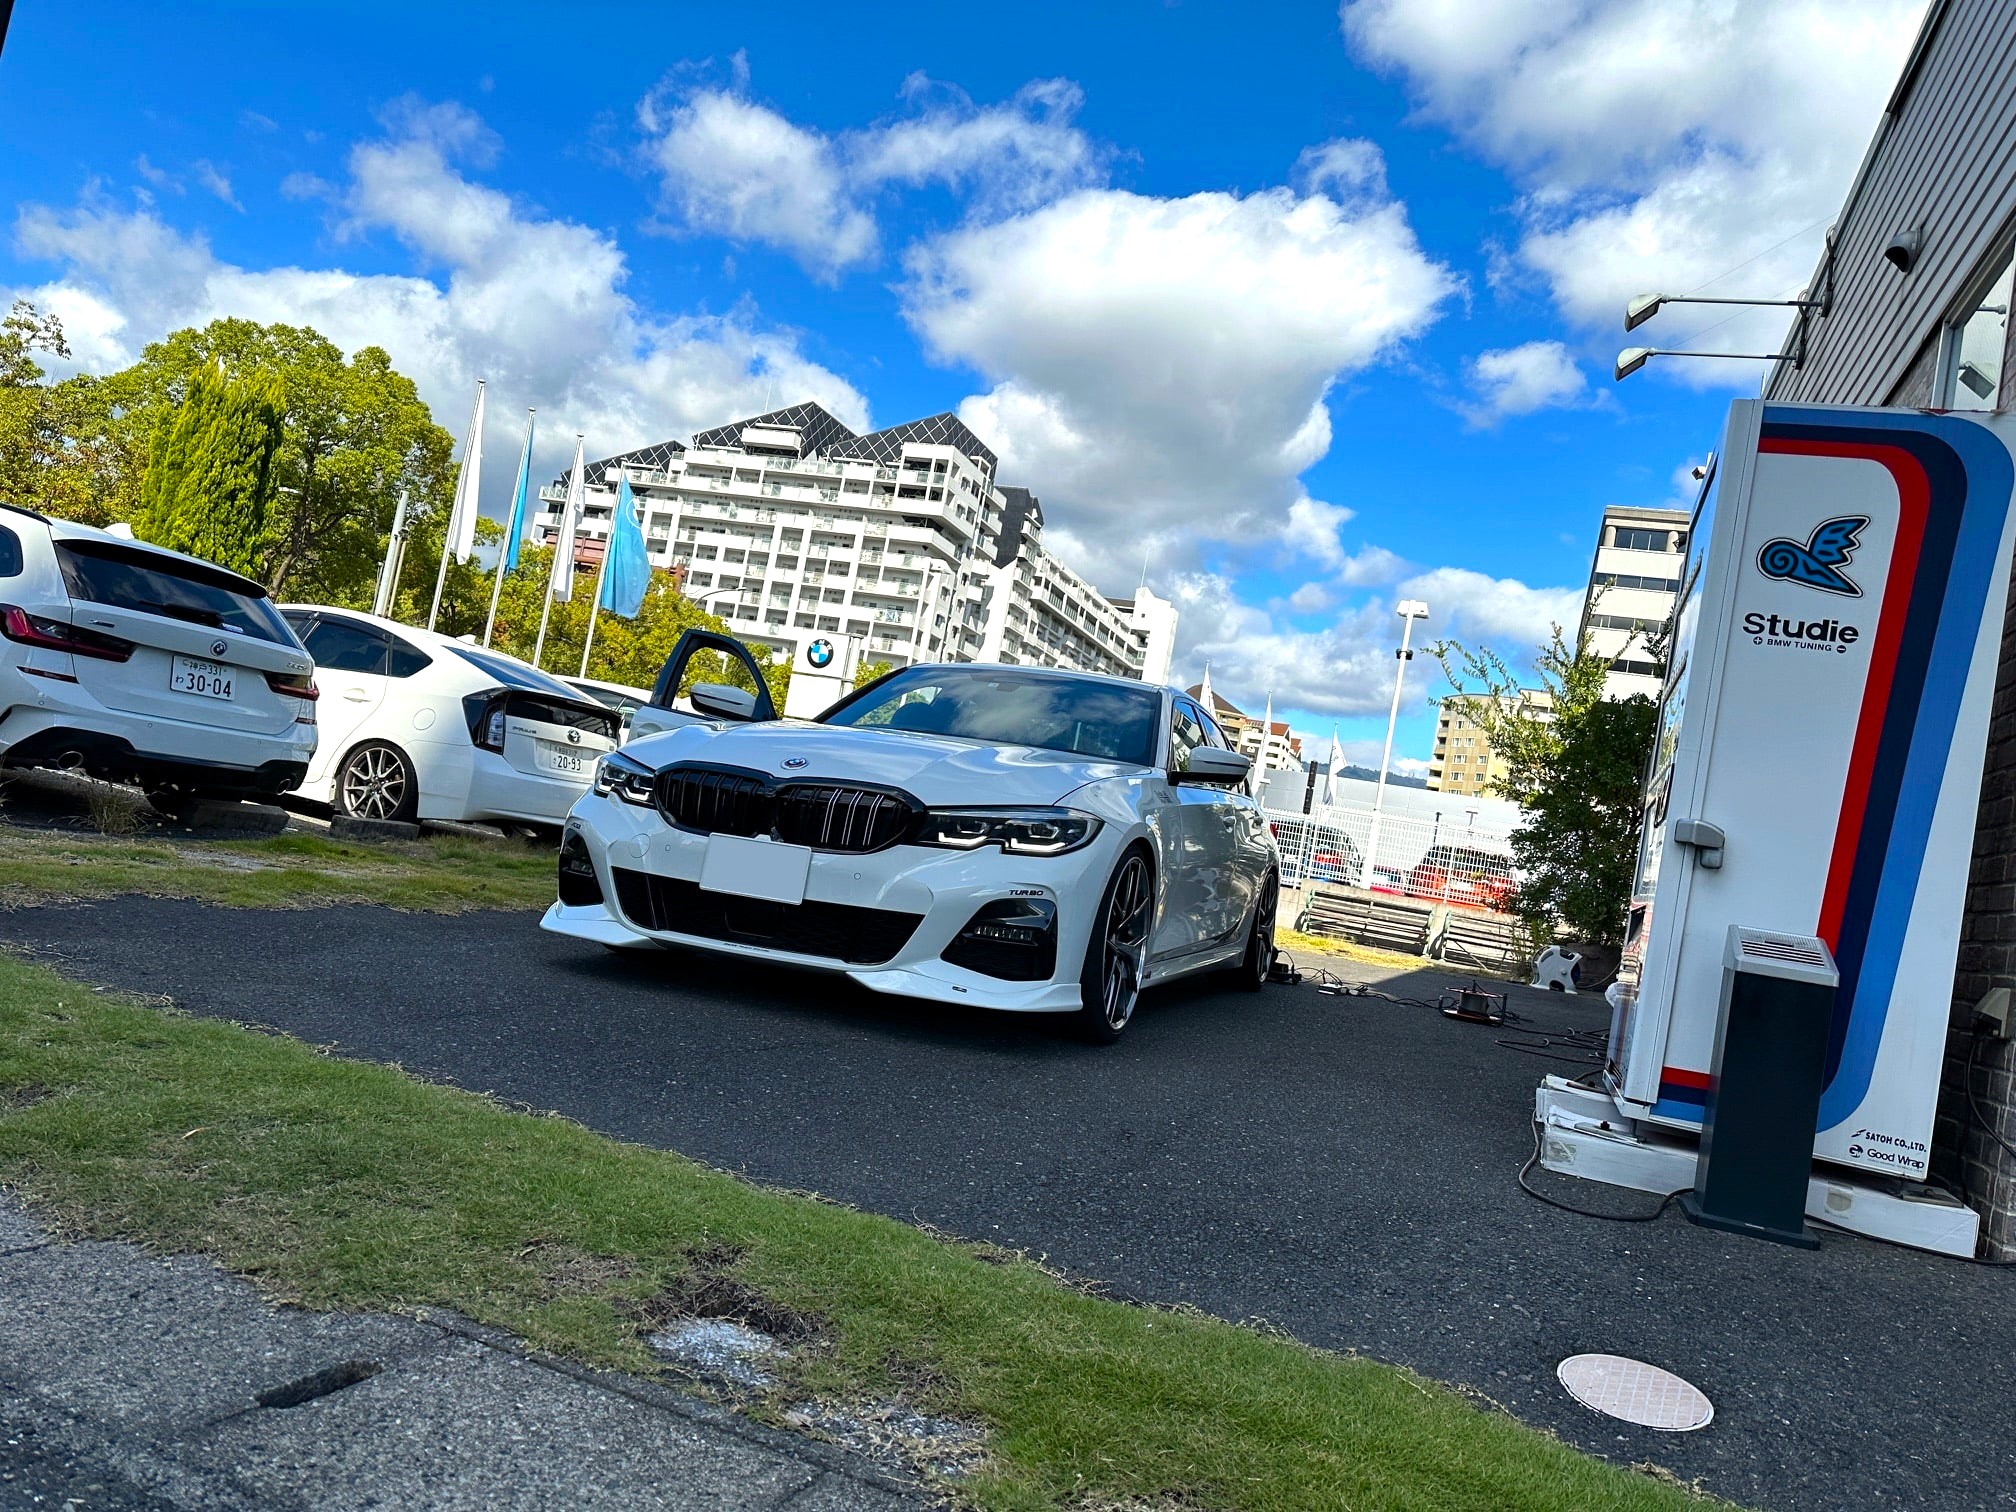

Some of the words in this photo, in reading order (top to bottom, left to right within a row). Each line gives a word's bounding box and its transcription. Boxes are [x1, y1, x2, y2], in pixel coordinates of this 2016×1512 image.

[1743, 612, 1859, 644] Studie
[1767, 638, 1792, 647] BMW
[1794, 641, 1832, 652] TUNING
[186, 673, 231, 697] 30-04
[1865, 1131, 1893, 1144] SATOH
[1867, 1148, 1896, 1162] Good
[1897, 1154, 1925, 1169] Wrap
